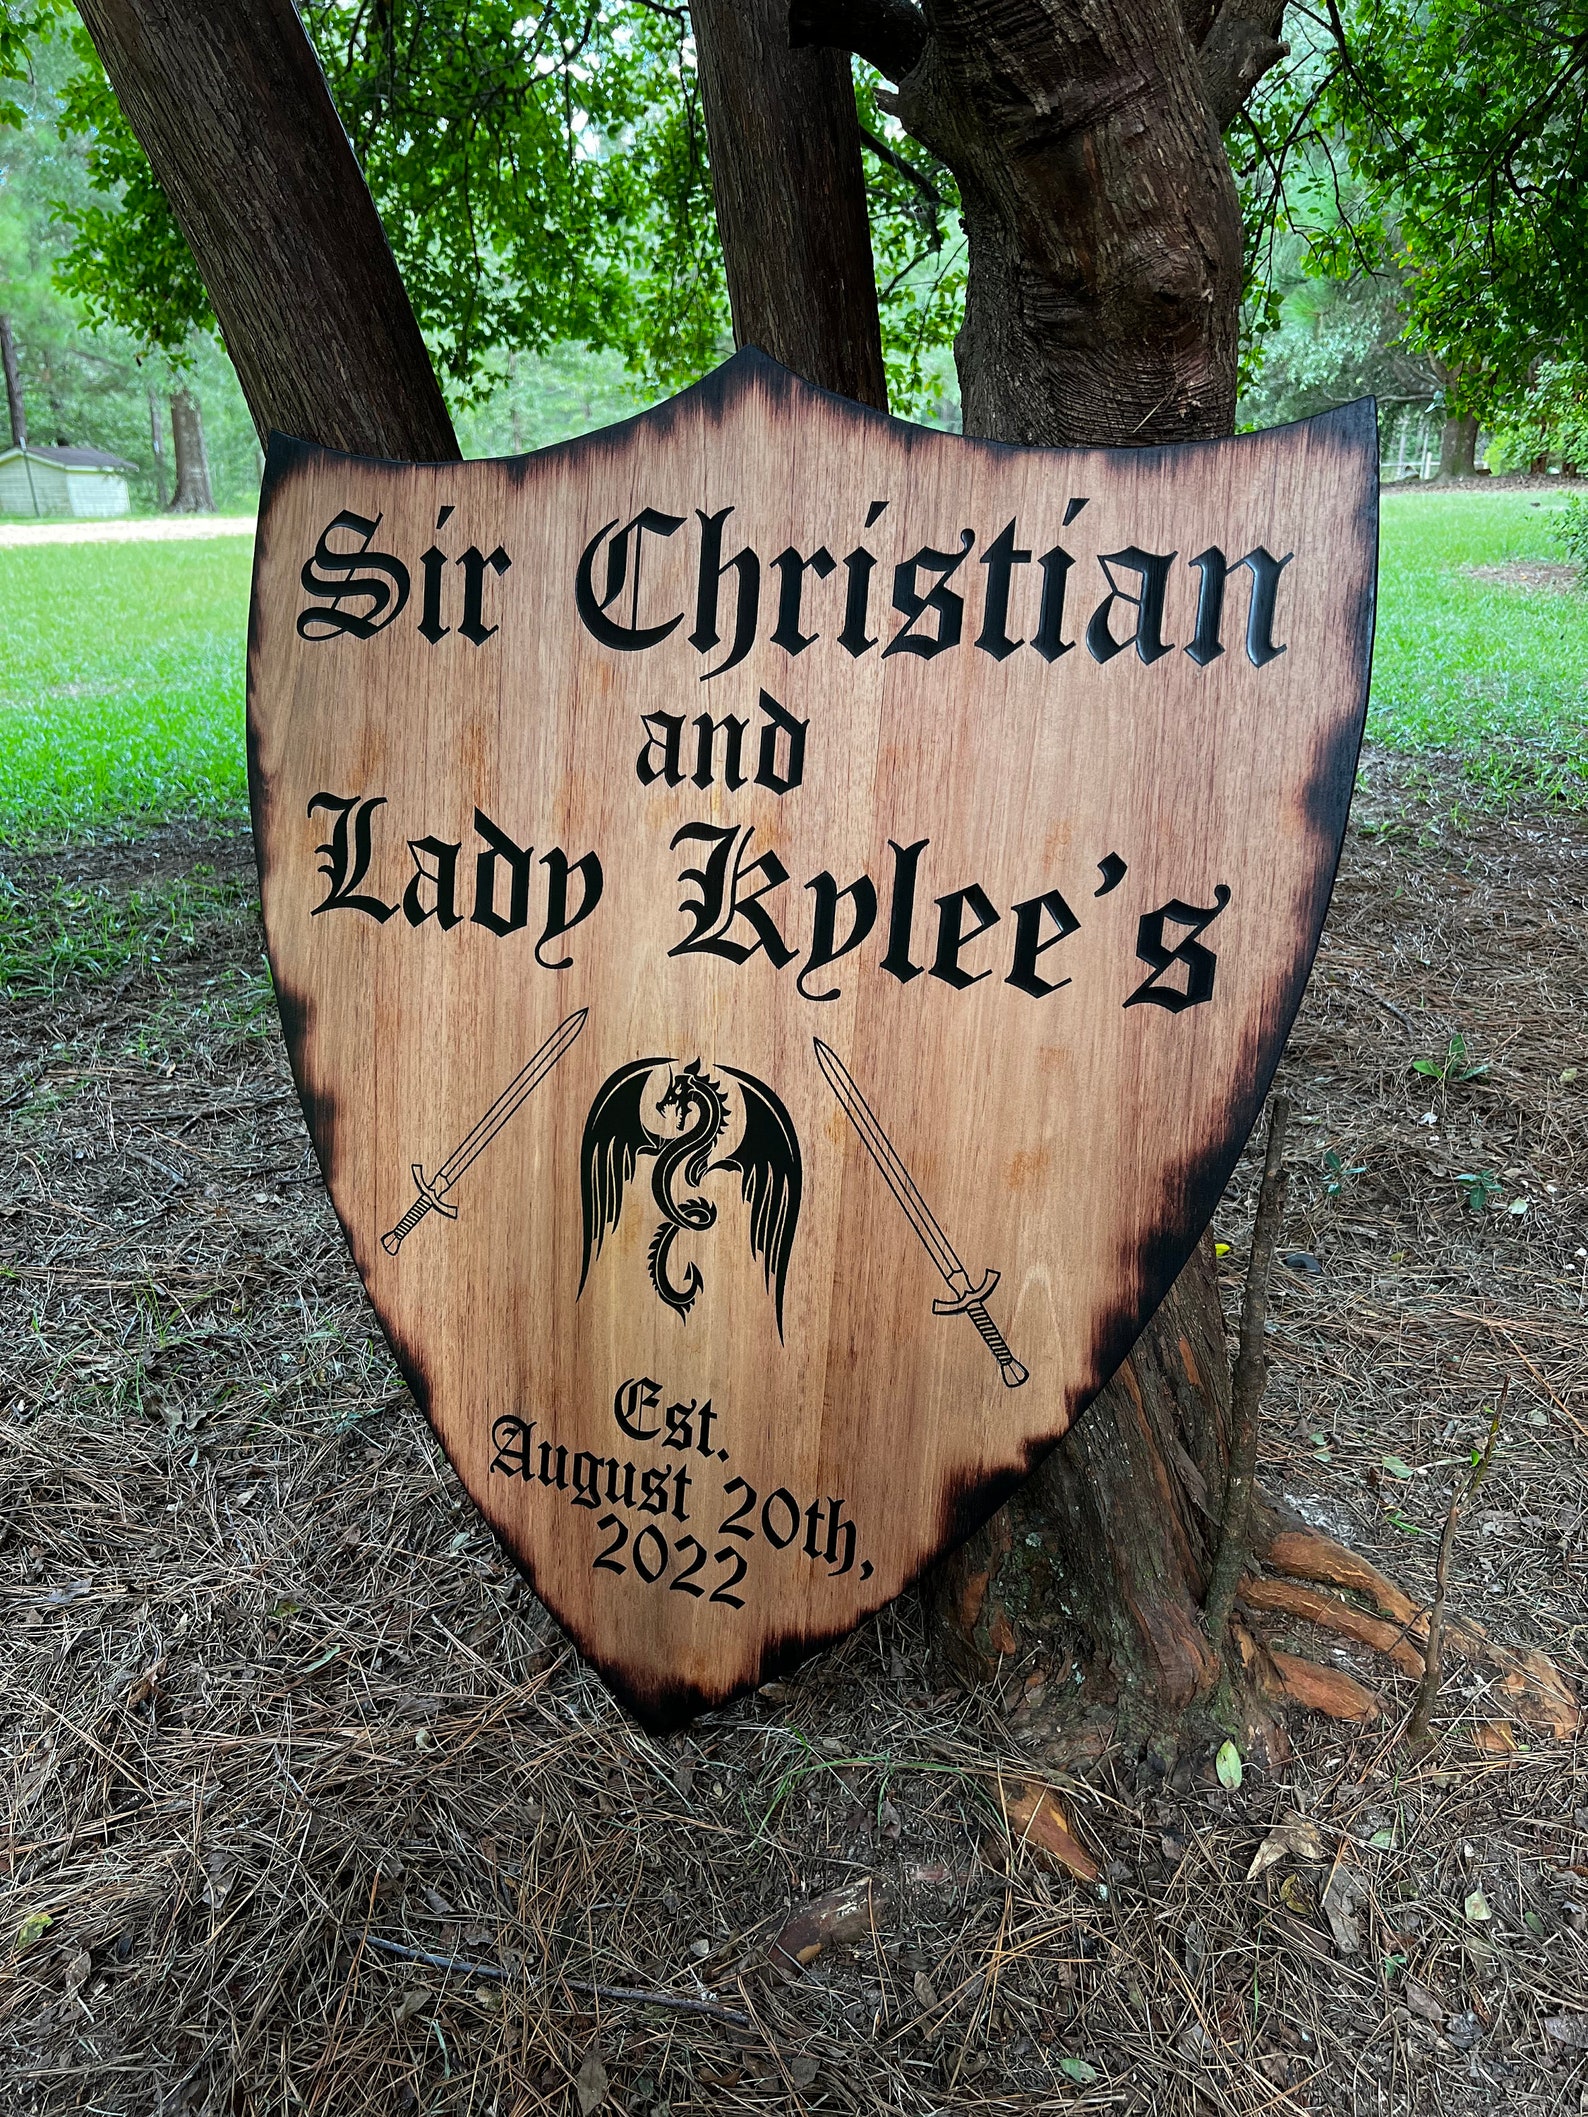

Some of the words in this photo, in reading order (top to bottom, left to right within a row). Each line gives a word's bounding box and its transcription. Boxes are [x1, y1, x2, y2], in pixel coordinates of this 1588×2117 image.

[296, 506, 513, 647] Sir
[575, 498, 1295, 682] Christian
[636, 688, 811, 796] and
[306, 792, 604, 970] Lady
[667, 822, 1232, 1015] Kylee's
[613, 1376, 730, 1463] Est.
[489, 1414, 693, 1523] August
[718, 1475, 875, 1581] 20th,
[592, 1513, 748, 1611] 2022
